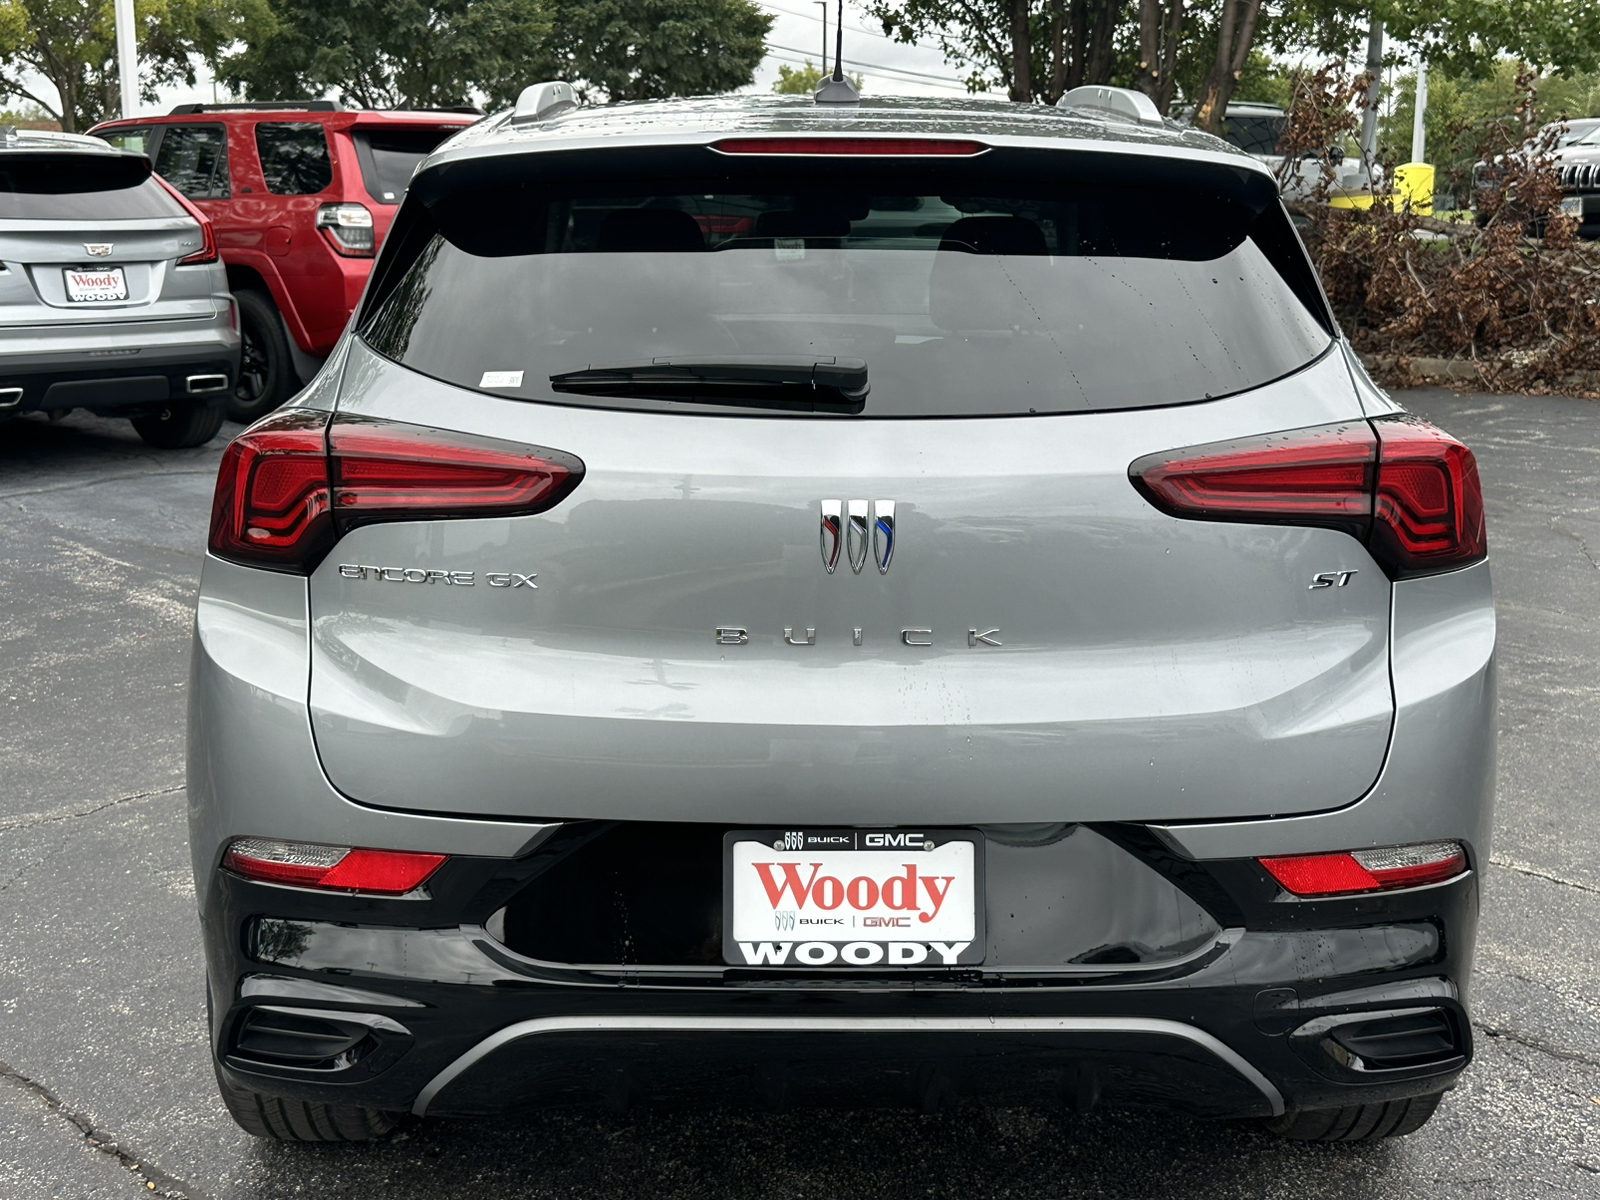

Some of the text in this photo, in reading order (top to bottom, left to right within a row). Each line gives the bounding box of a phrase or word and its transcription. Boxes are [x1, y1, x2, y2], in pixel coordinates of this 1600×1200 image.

[71, 274, 119, 289] Woody
[71, 292, 125, 301] WOODY
[339, 563, 538, 589] ENCORE GX
[1308, 569, 1358, 590] ST
[715, 627, 1003, 646] BUICK
[865, 833, 924, 847] GMC
[751, 862, 956, 923] Woody
[863, 916, 911, 928] GMC
[738, 941, 971, 965] WOODY
